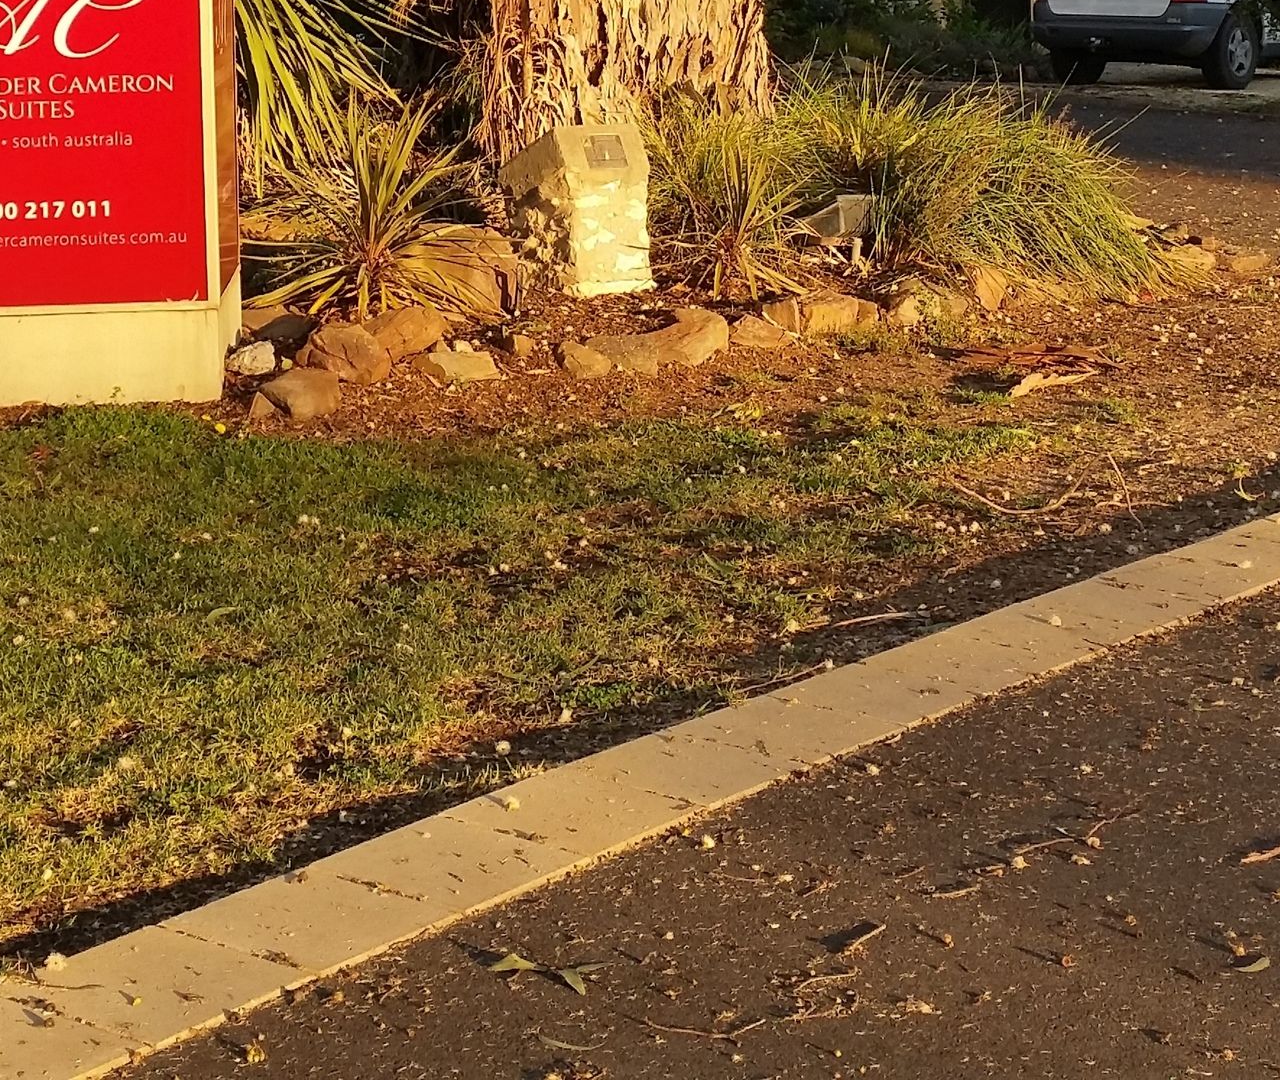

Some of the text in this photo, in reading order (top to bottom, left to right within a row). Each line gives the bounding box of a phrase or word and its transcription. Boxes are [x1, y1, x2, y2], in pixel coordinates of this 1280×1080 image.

[48, 73, 174, 94] CAMERON
[12, 132, 59, 149] south
[64, 130, 133, 148] australia
[24, 200, 66, 220] 217
[71, 199, 111, 219] 011
